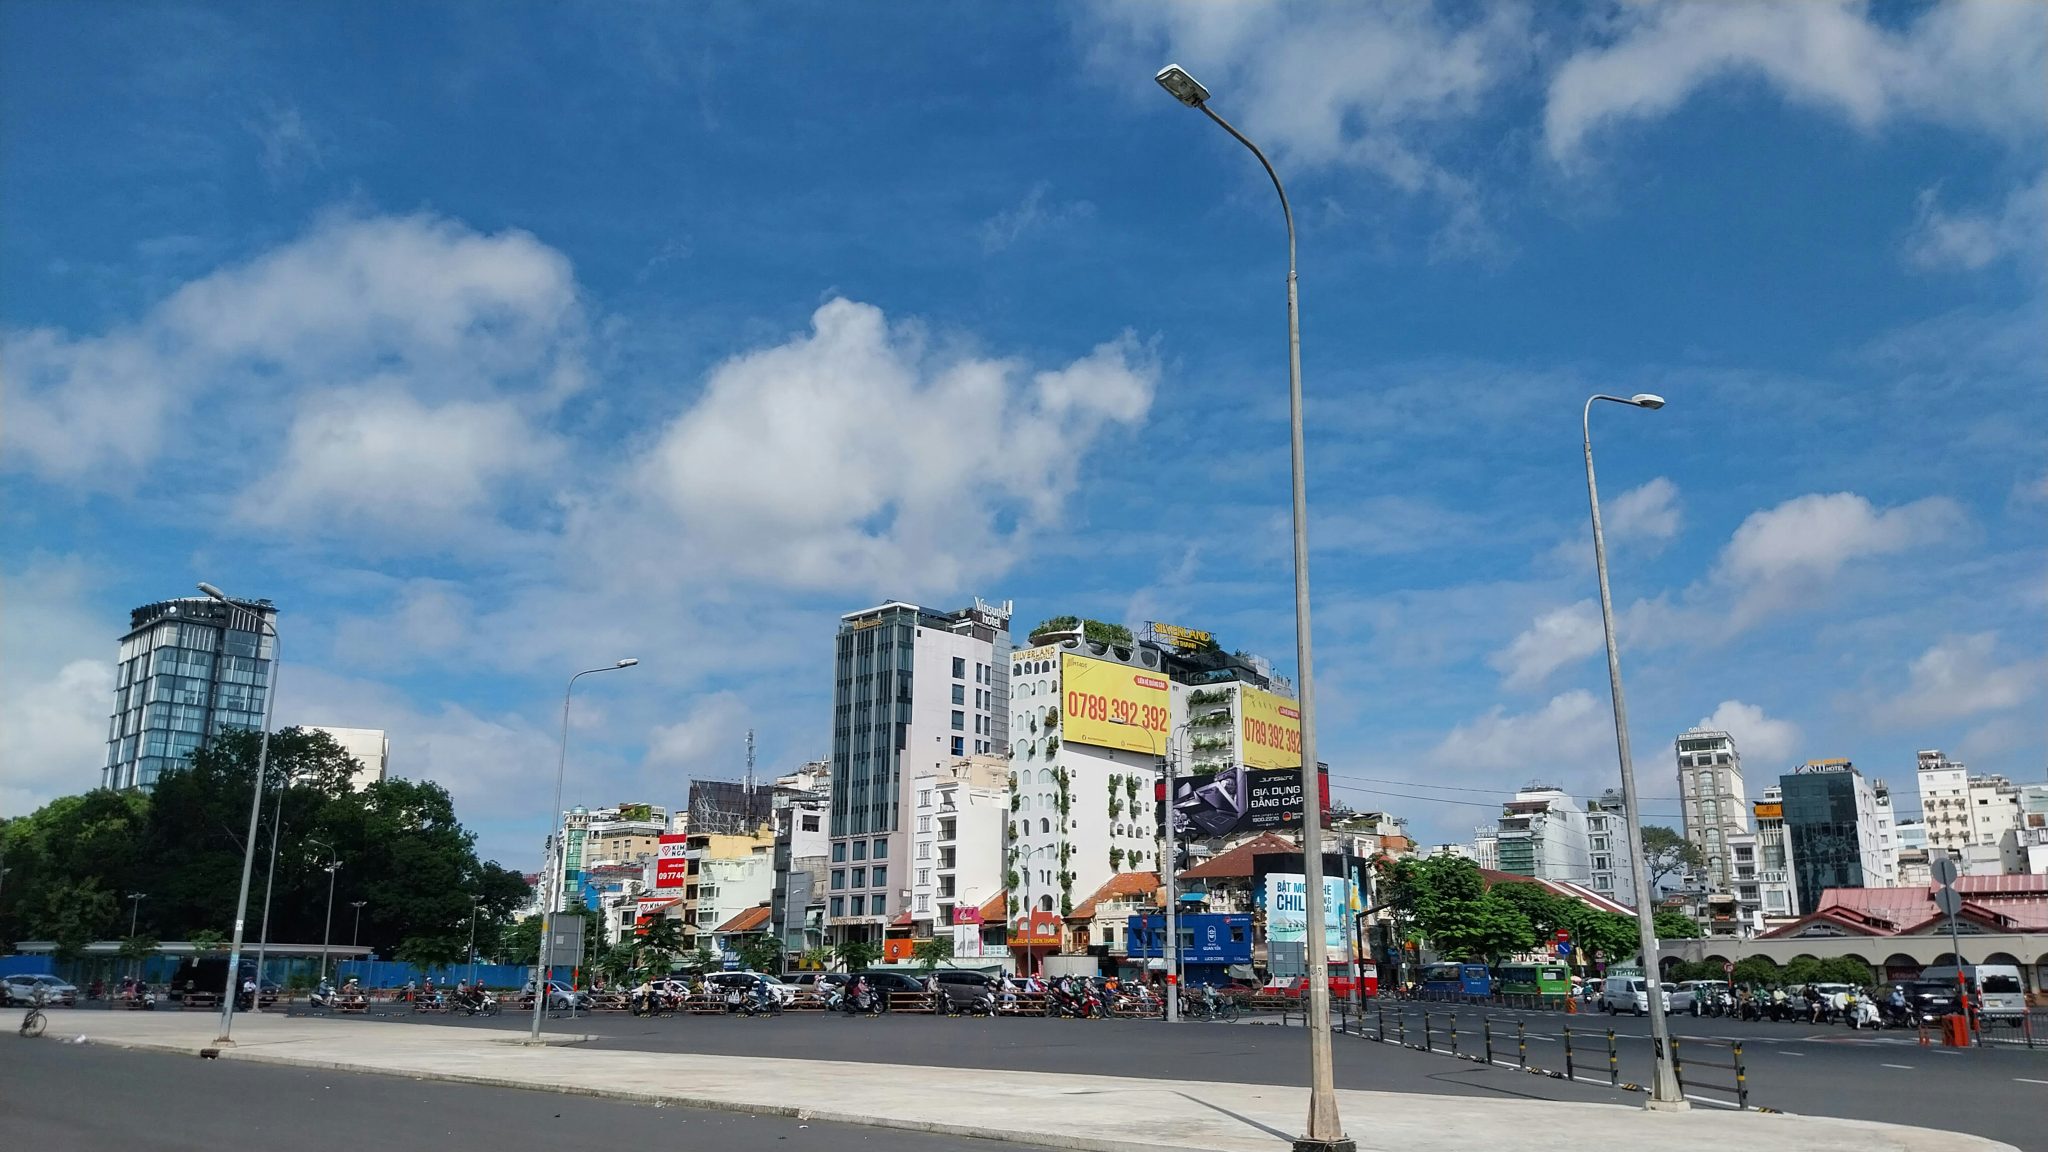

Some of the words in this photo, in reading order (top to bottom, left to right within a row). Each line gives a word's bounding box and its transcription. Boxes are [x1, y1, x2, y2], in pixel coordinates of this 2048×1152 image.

[982, 612, 1001, 628] hotel
[1154, 622, 1210, 642] SILVERLAND
[1013, 646, 1056, 661] SILVERLAND
[1068, 690, 1107, 722] 0789
[1111, 698, 1139, 726] 392
[1141, 704, 1168, 733] 392
[1244, 716, 1267, 746] 0789
[1268, 723, 1285, 750] 392
[1286, 728, 1302, 755] 392
[1252, 787, 1270, 797] GIA
[1271, 785, 1301, 797] DỤNG
[1281, 794, 1304, 806] CẤP
[1276, 879, 1292, 895] BẬT
[1276, 893, 1306, 911] CHIL
